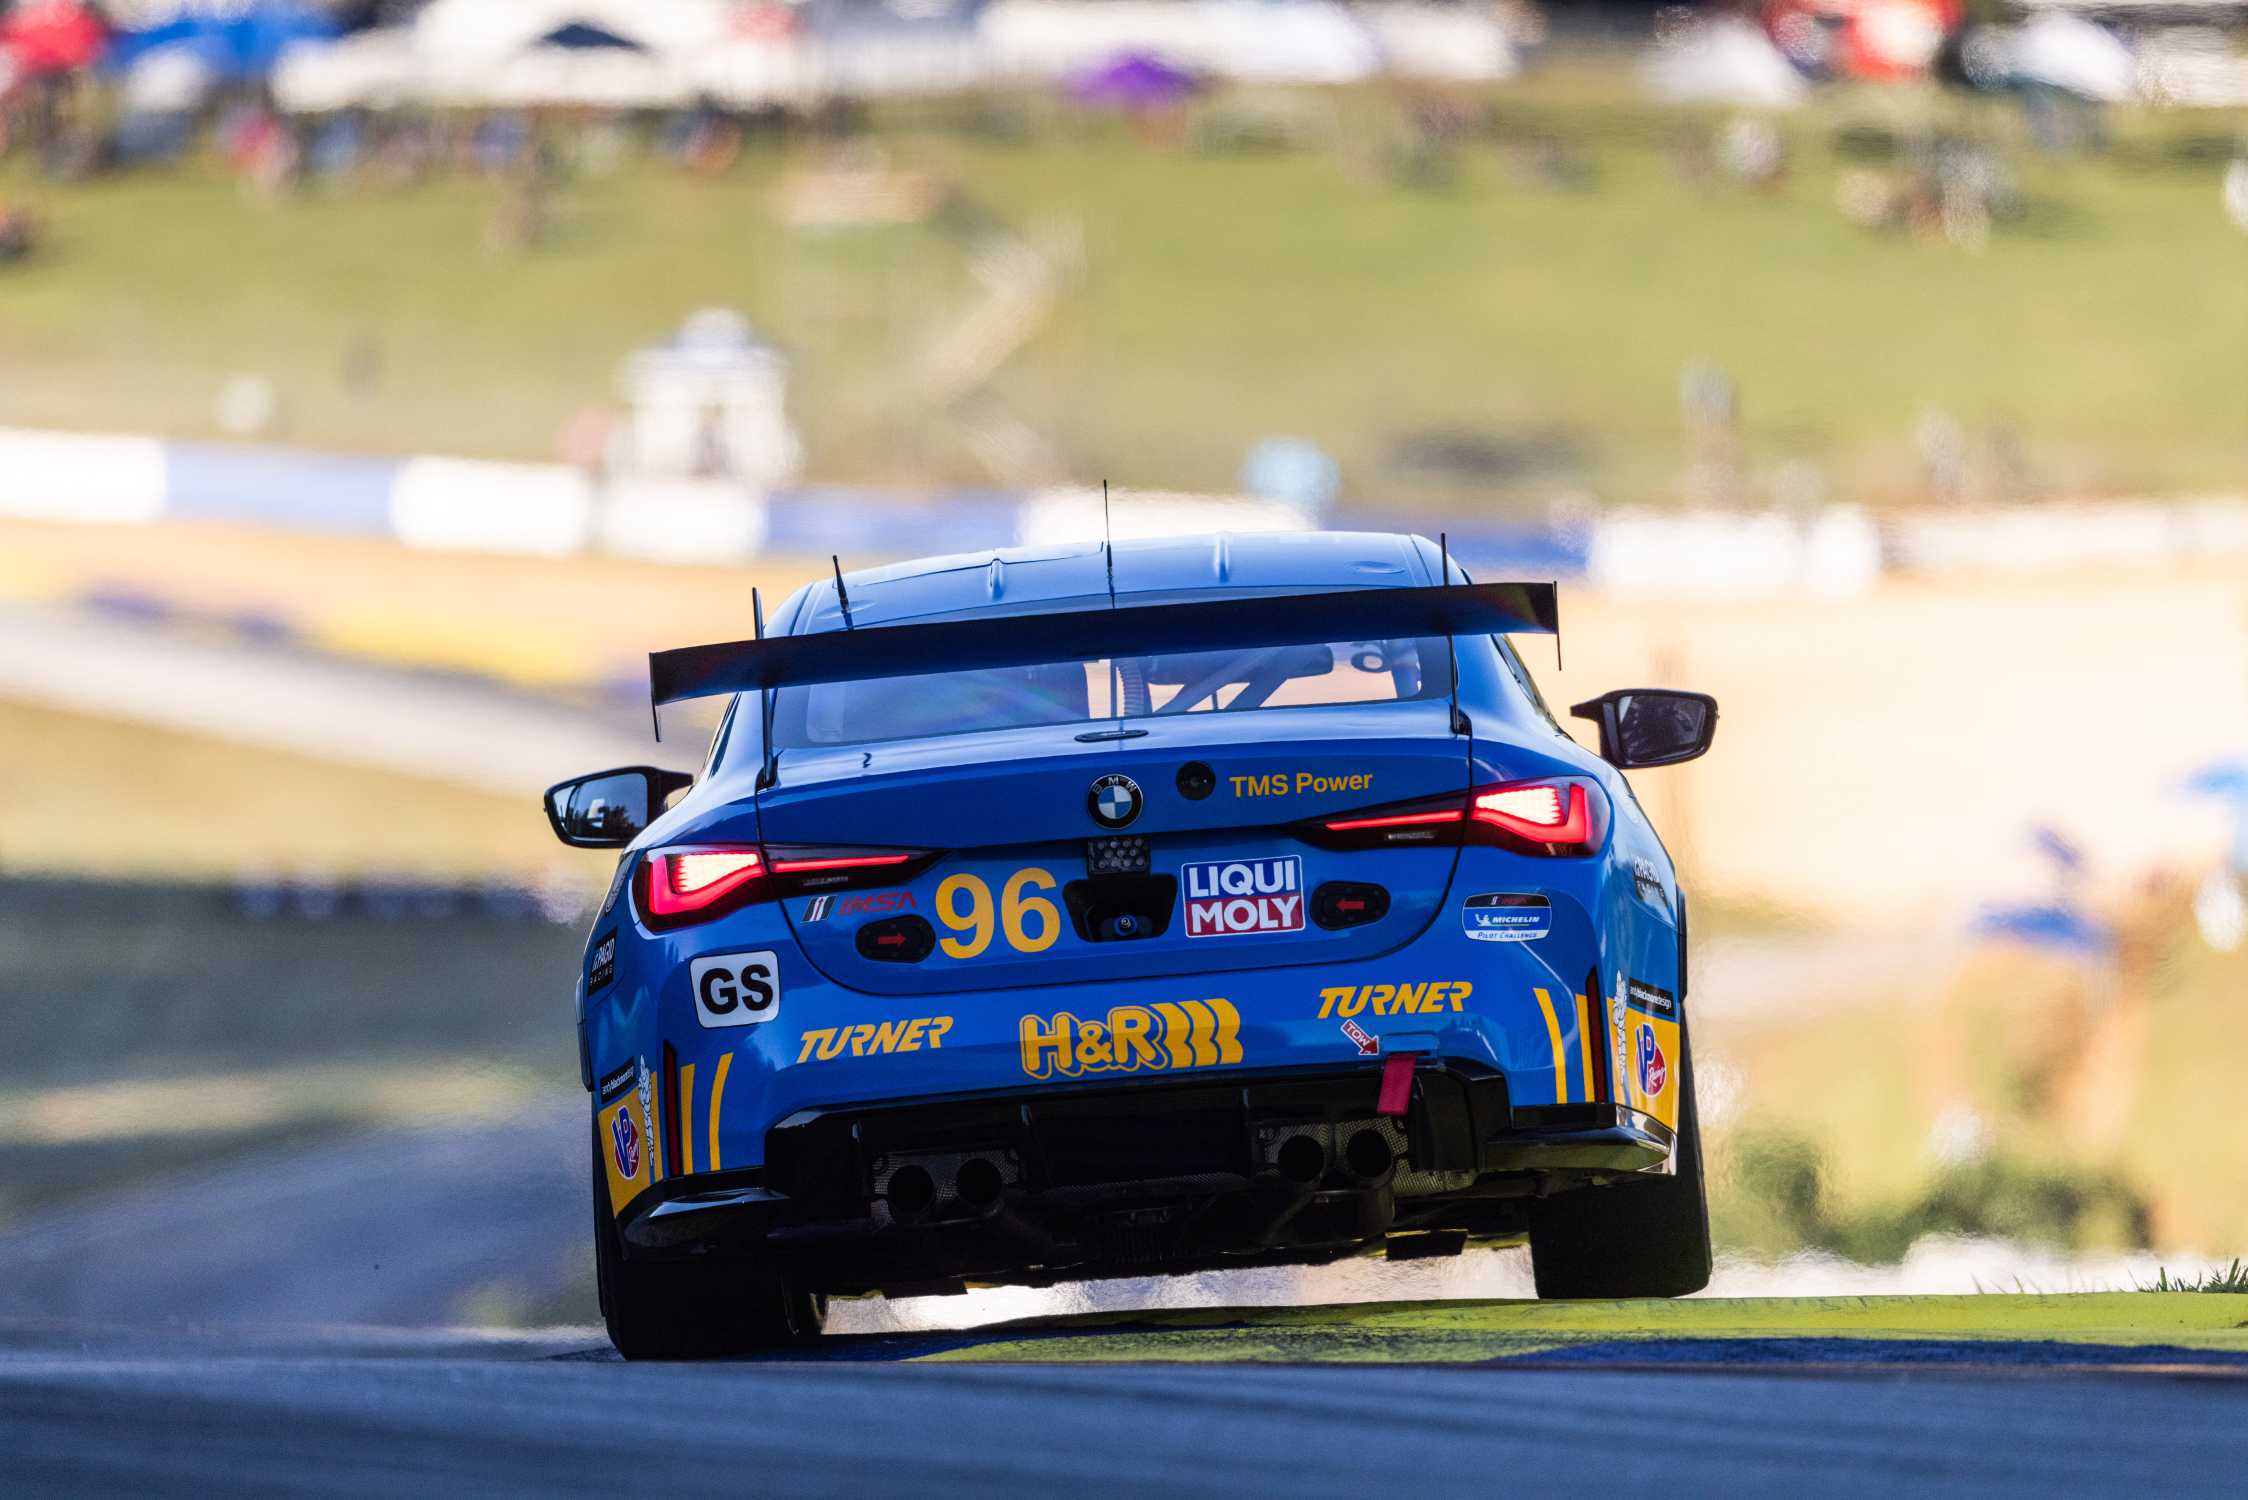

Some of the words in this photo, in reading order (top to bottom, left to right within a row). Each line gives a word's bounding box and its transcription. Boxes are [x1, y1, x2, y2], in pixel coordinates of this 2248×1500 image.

[1229, 773, 1289, 798] TMS
[1296, 772, 1373, 794] Power
[1188, 860, 1296, 898] LIQUI
[935, 868, 1061, 959] 96
[1191, 895, 1300, 933] MOLY
[1491, 915, 1540, 924] MICHELIN
[699, 963, 774, 1014] GS
[1317, 981, 1473, 1019] TURNER
[796, 1015, 954, 1064] TURNER
[1019, 1005, 1168, 1080] H&R
[1346, 1022, 1372, 1047] TOW
